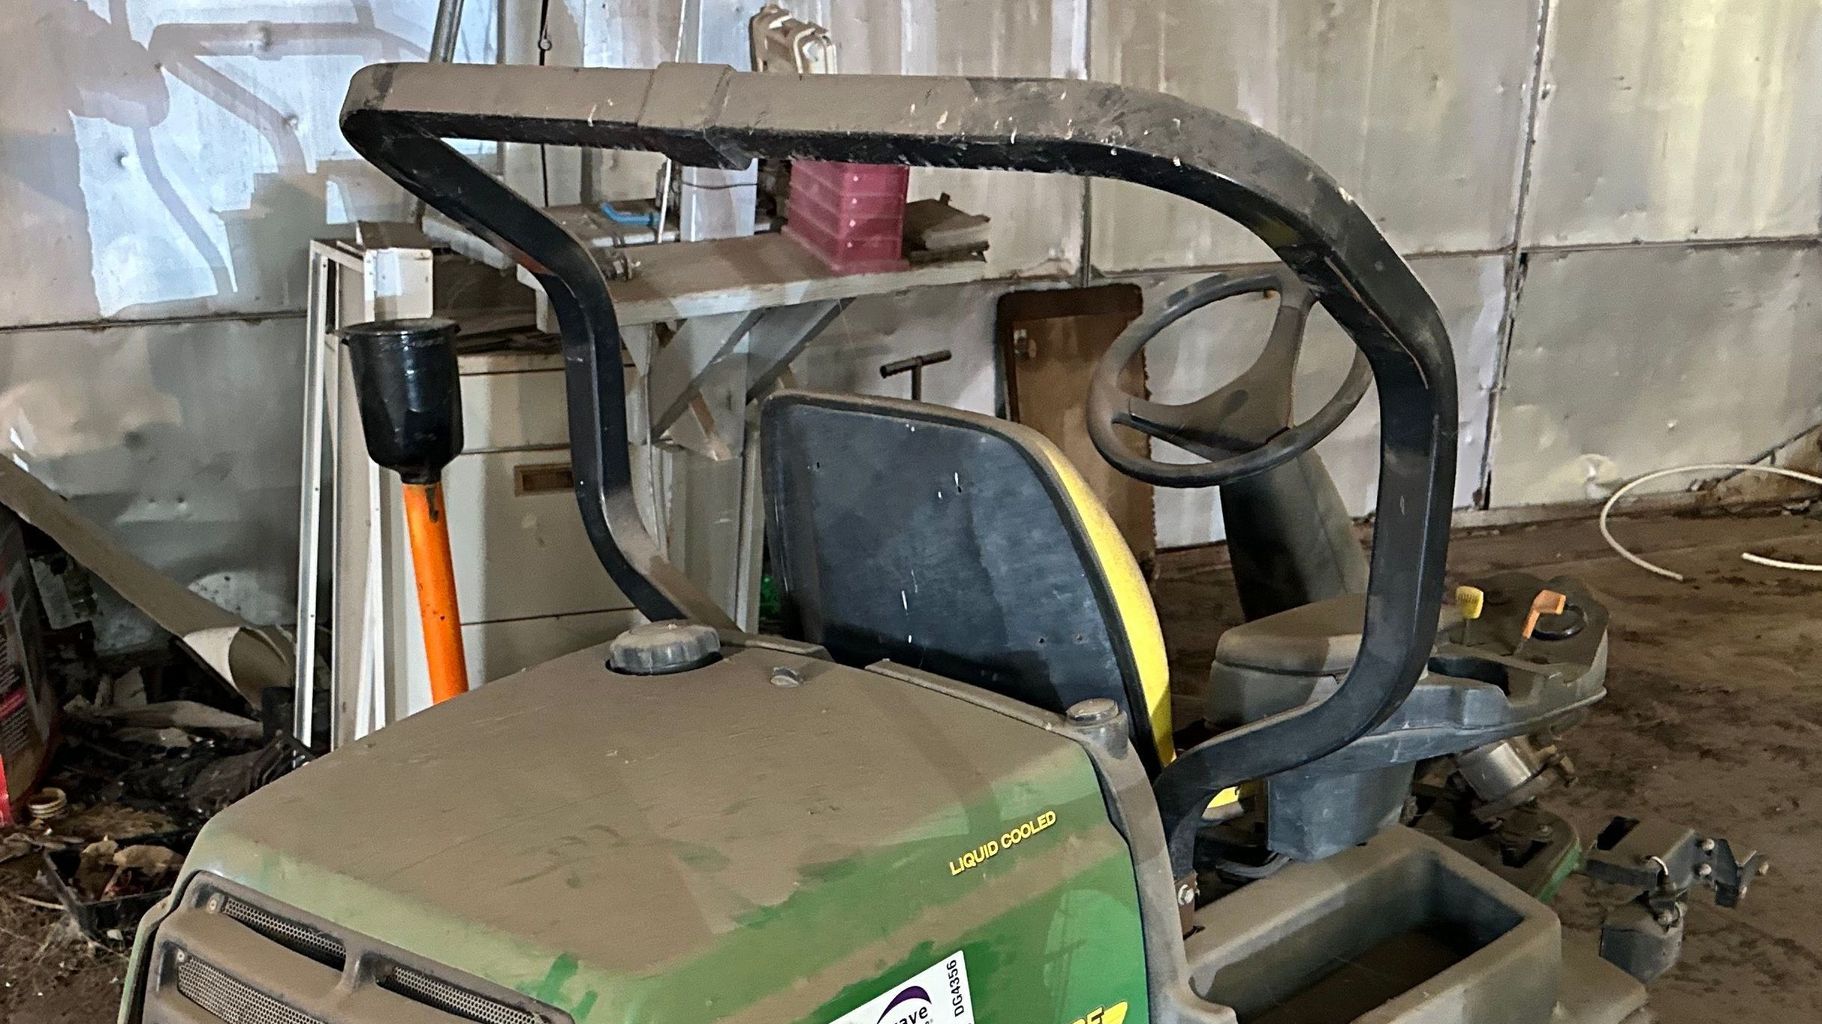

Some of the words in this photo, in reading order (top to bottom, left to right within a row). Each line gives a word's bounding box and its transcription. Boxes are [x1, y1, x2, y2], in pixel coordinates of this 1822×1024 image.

[949, 840, 999, 875] LIQUID
[1000, 810, 1057, 851] COOLED
[946, 959, 965, 1018] DG4356
